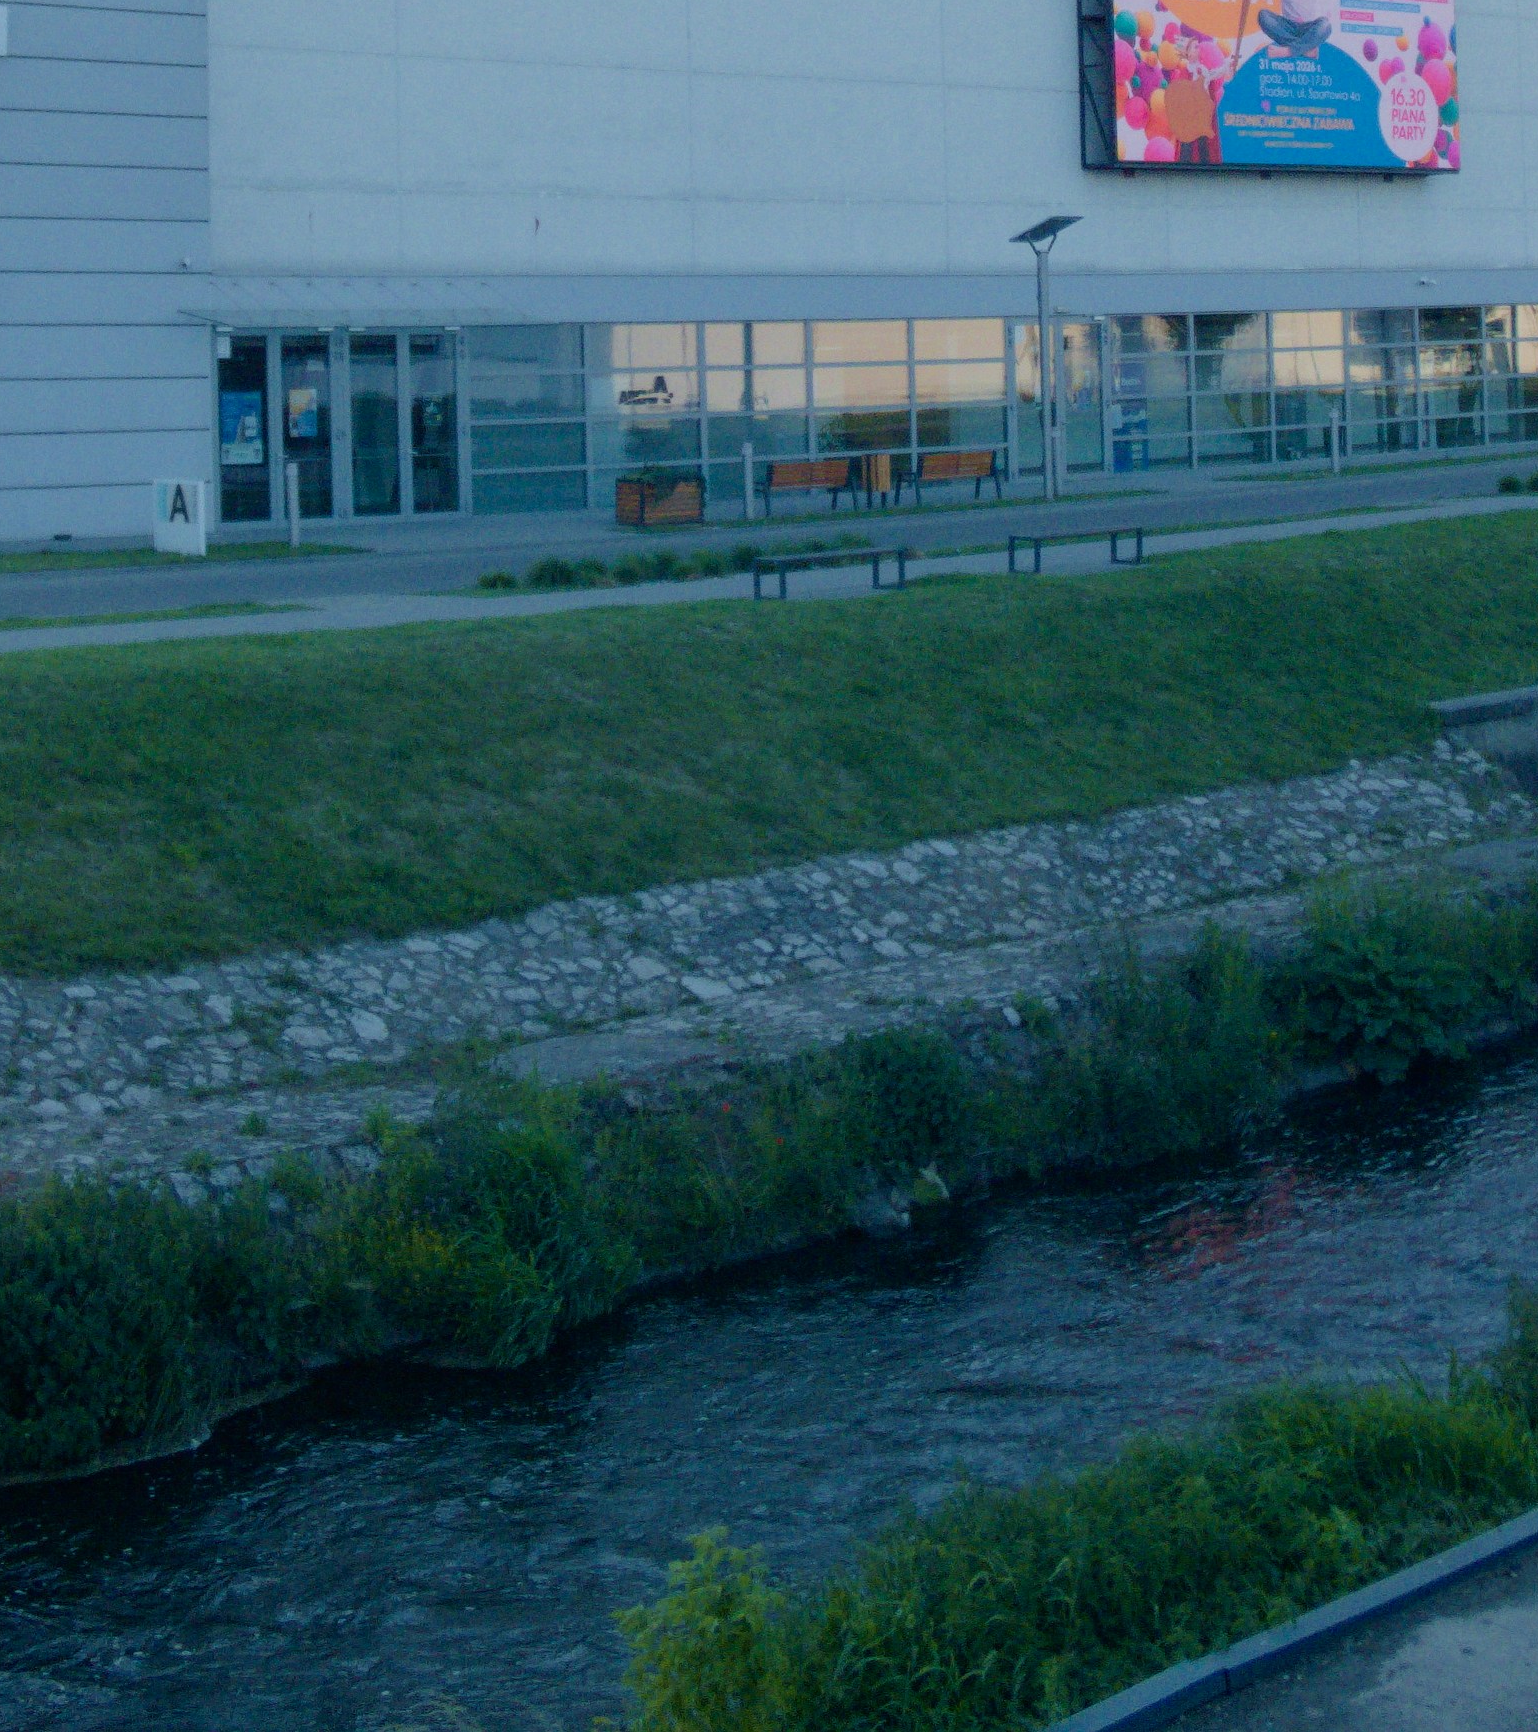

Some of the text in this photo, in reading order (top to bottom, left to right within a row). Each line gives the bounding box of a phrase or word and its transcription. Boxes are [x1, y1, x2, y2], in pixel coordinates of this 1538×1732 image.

[1258, 58, 1269, 69] 31
[1271, 60, 1294, 73] maja
[1391, 88, 1426, 107] 16.30
[1391, 108, 1426, 124] PIANA
[1392, 125, 1426, 141] PARTY
[169, 483, 190, 523] A
